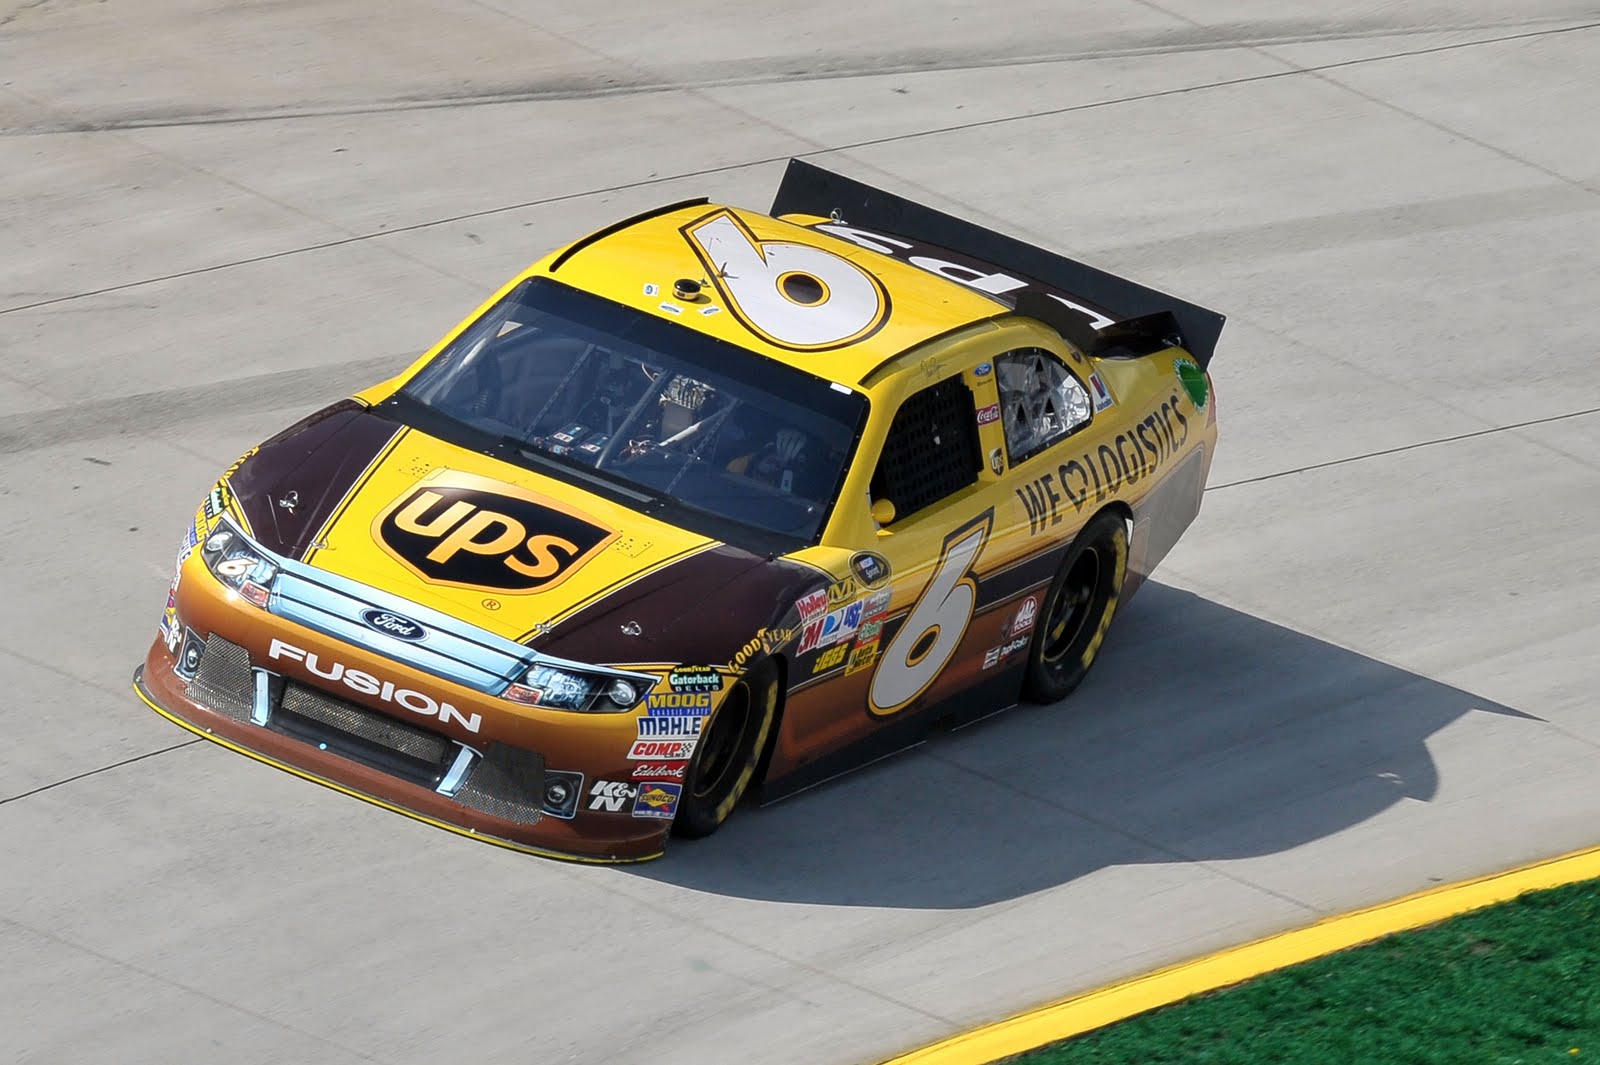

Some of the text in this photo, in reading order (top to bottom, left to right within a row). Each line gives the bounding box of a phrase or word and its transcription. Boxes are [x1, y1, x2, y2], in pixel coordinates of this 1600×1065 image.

[679, 207, 892, 352] 6
[1016, 394, 1188, 536] WE LOGISTICS
[394, 490, 579, 578] ups
[217, 558, 258, 576] 6
[797, 593, 828, 620] Holley
[865, 506, 994, 720] 6
[373, 612, 416, 639] Ford
[798, 617, 825, 654] 3M
[268, 638, 482, 733] FUSION
[669, 673, 720, 685] Gatorback
[675, 684, 719, 692] BELTS
[648, 693, 710, 708] MOOG
[651, 707, 709, 716] CHASSIS PARTS
[638, 717, 702, 736] MAHLE
[632, 742, 683, 756] COMP
[632, 764, 684, 778] Edelbrock
[640, 793, 677, 804] SUNOCO
